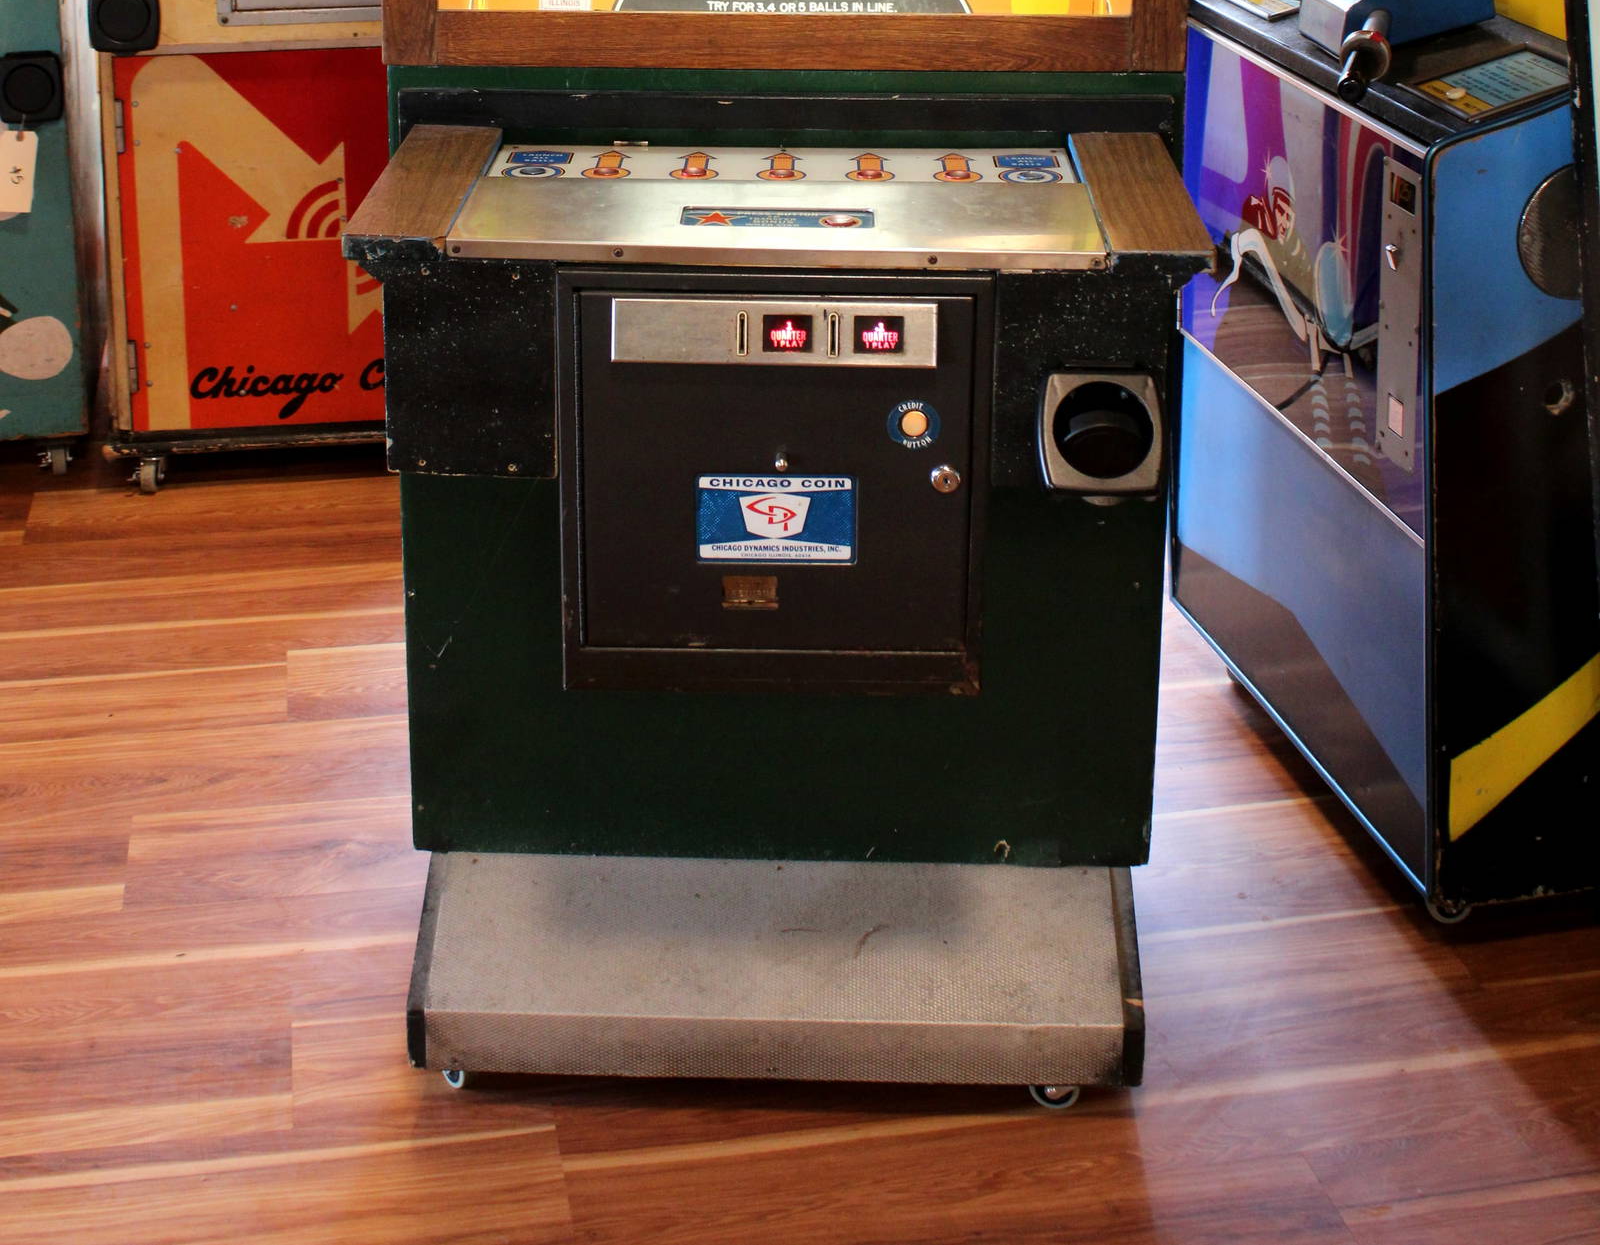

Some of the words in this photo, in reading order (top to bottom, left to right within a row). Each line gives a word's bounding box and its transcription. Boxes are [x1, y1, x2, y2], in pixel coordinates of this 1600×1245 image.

[706, 0, 730, 12] TRY
[732, 1, 754, 13] FOR
[779, 2, 797, 13] OR
[797, 1, 806, 13] 5
[809, 1, 849, 13] BALLS
[852, 1, 864, 13] IN
[867, 1, 898, 13] LINE.
[770, 329, 807, 341] QUARTER
[862, 331, 899, 343] QUARTER
[780, 340, 804, 348] PLAY
[190, 364, 345, 420] Chicago
[898, 402, 924, 413] CREDIT
[709, 478, 792, 488] CHICAGO
[801, 479, 846, 488] COIN
[711, 544, 743, 553] CHICAGO
[744, 544, 781, 553] DYNAMICS
[782, 545, 826, 554] INDUSTRIES,
[827, 545, 842, 554] INC.
